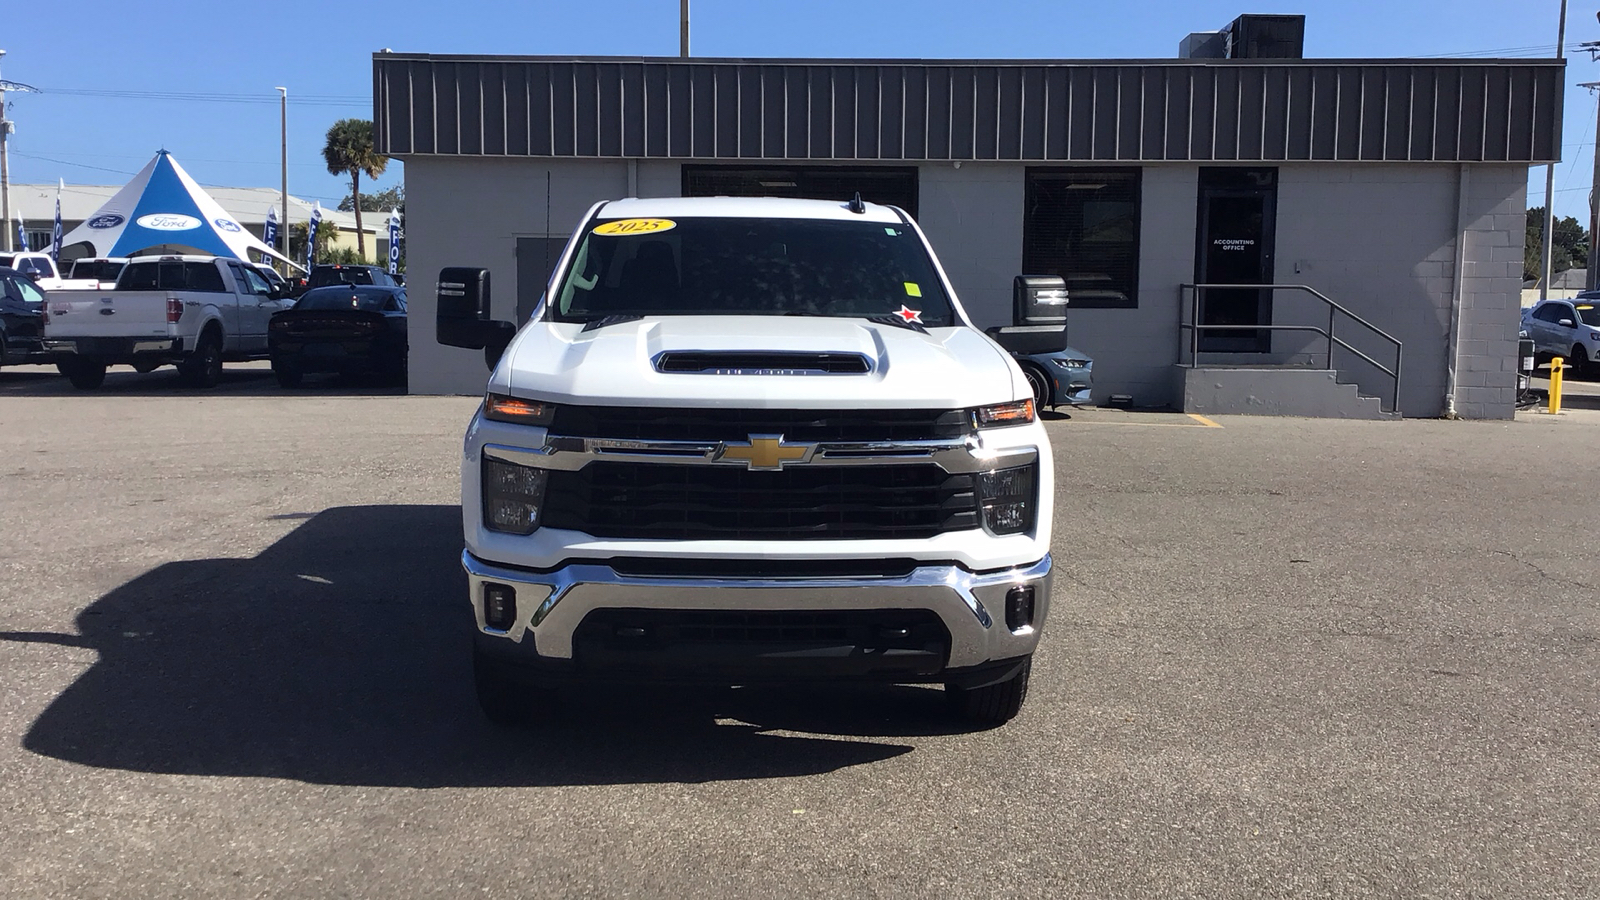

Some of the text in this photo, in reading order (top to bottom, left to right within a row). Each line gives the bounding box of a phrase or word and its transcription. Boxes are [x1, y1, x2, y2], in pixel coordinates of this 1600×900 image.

[93, 216, 119, 227] Ford
[150, 216, 187, 228] Ford
[607, 221, 664, 233] 2025
